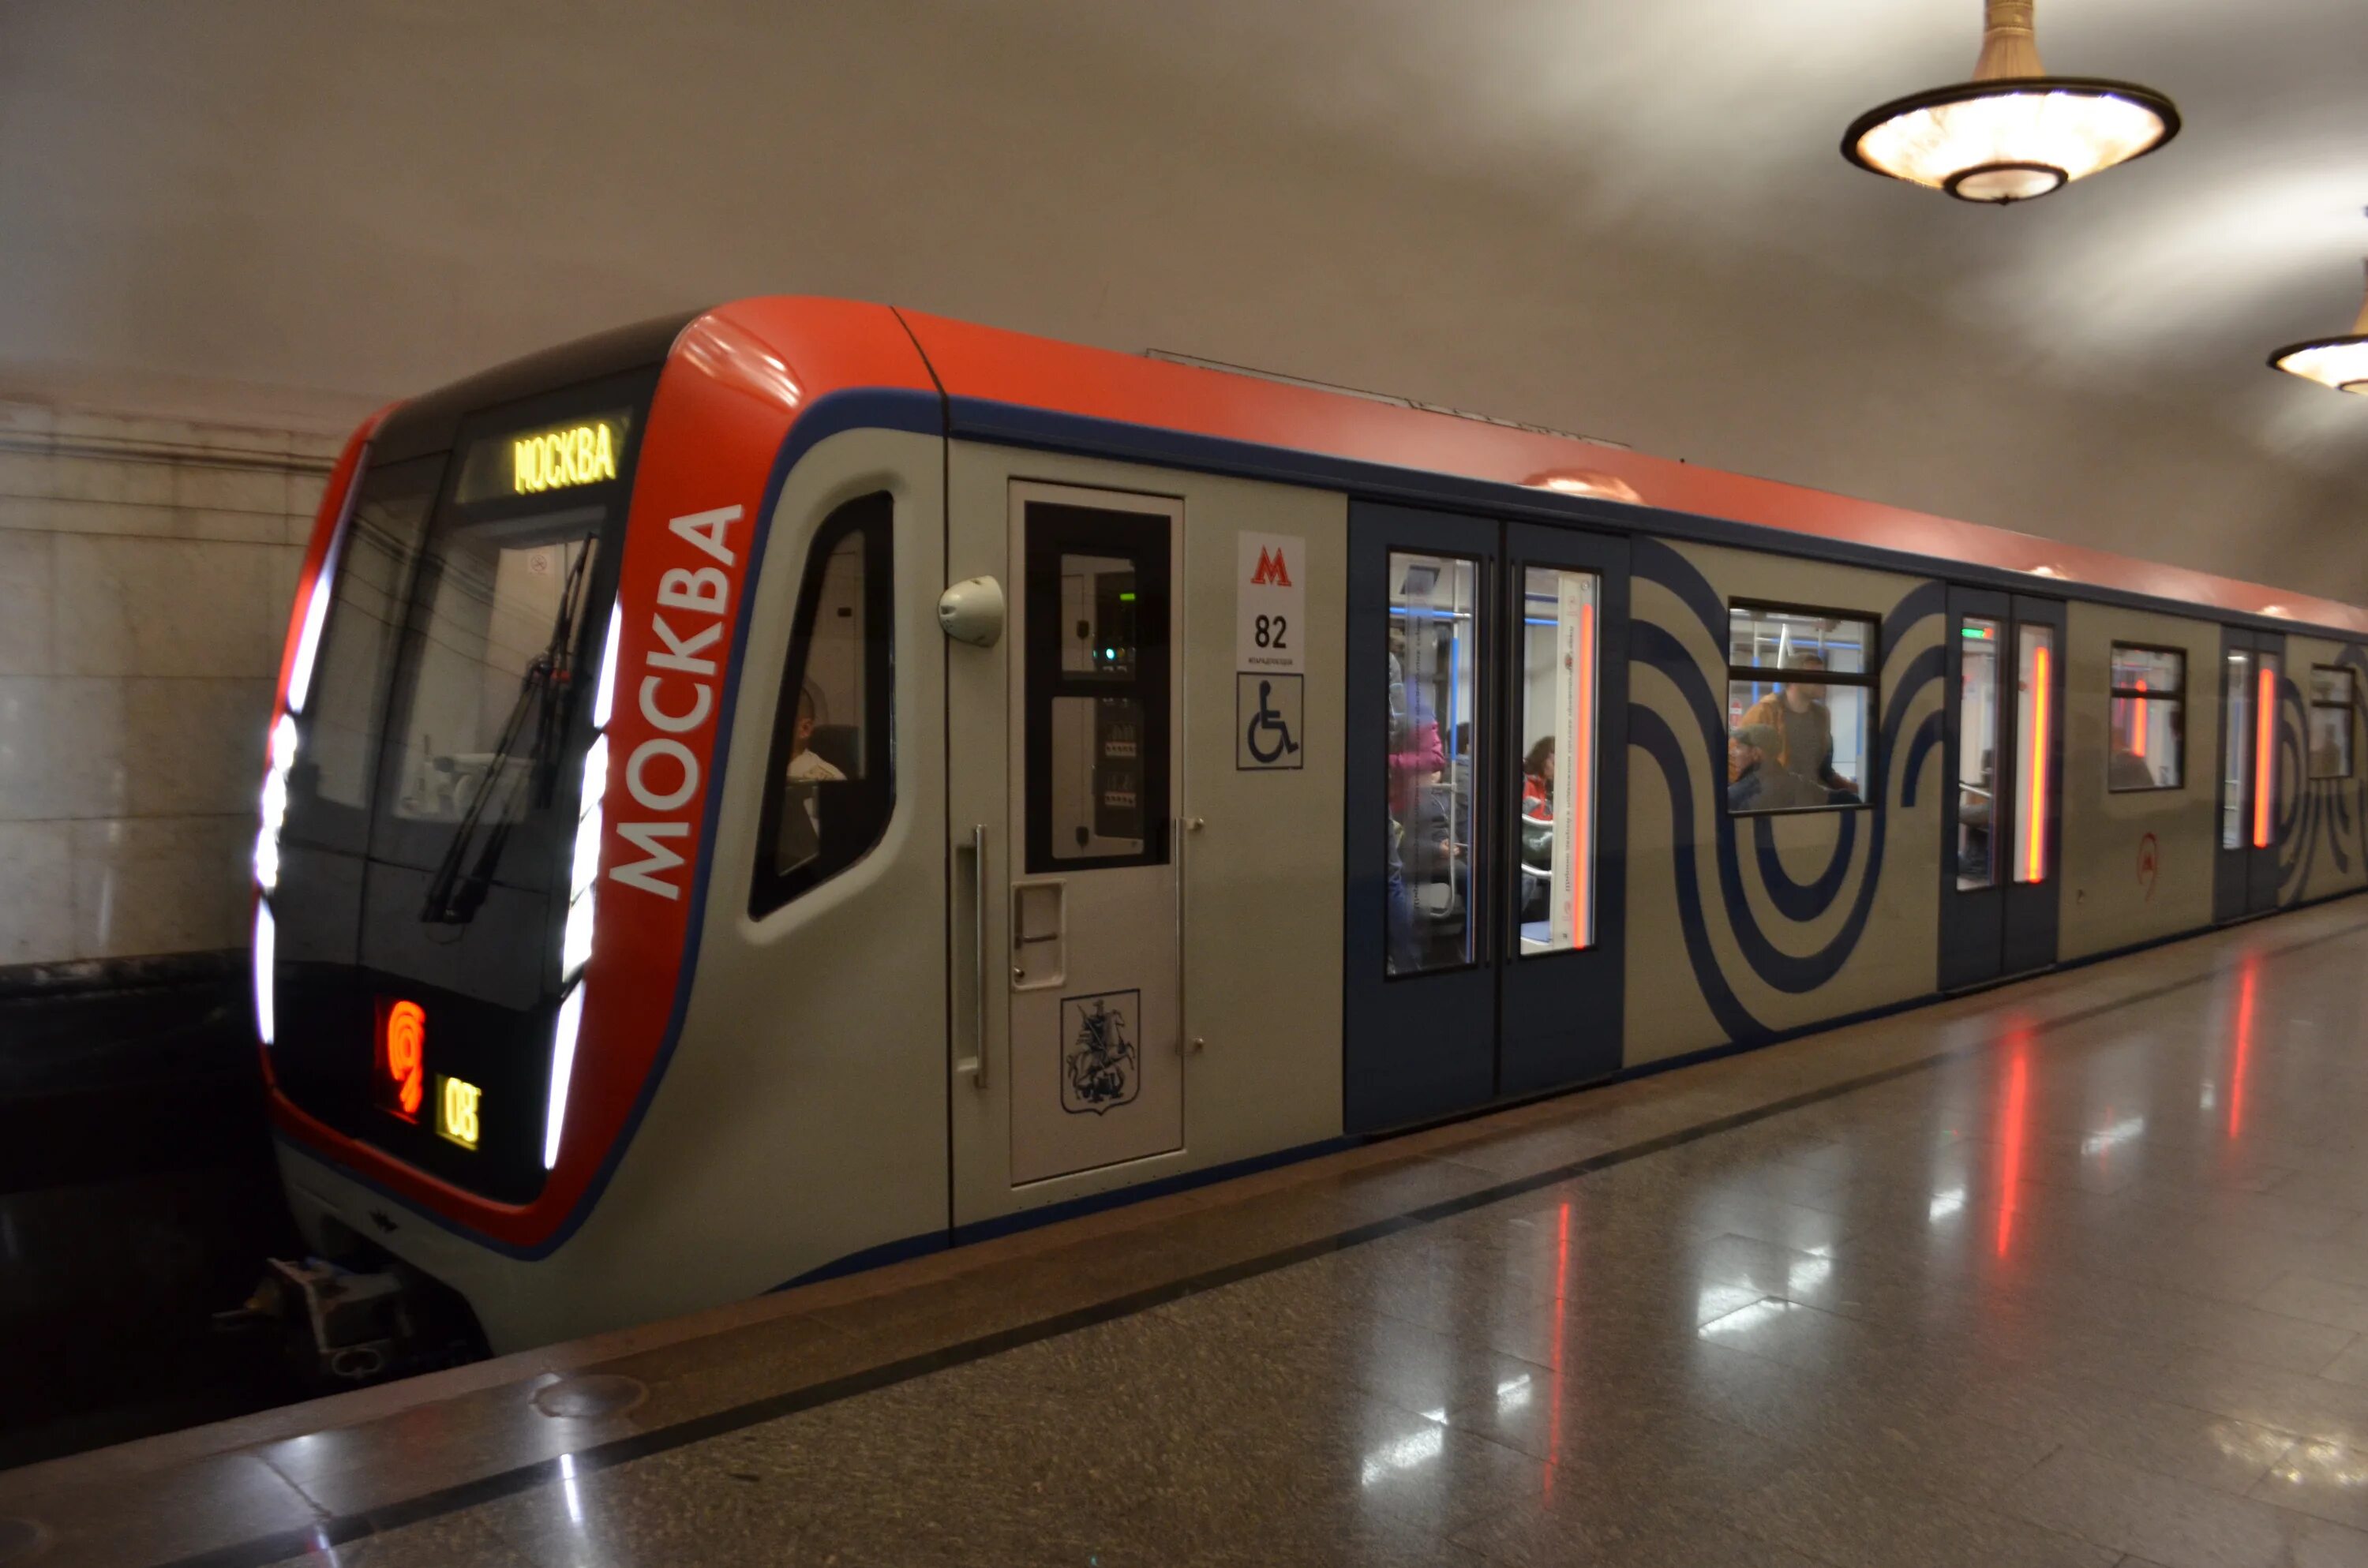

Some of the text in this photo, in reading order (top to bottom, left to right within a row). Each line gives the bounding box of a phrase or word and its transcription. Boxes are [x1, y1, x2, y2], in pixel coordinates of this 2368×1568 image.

[515, 423, 616, 496] МОСКВА
[1254, 614, 1287, 649] 82
[609, 503, 744, 900] МОСКВА
